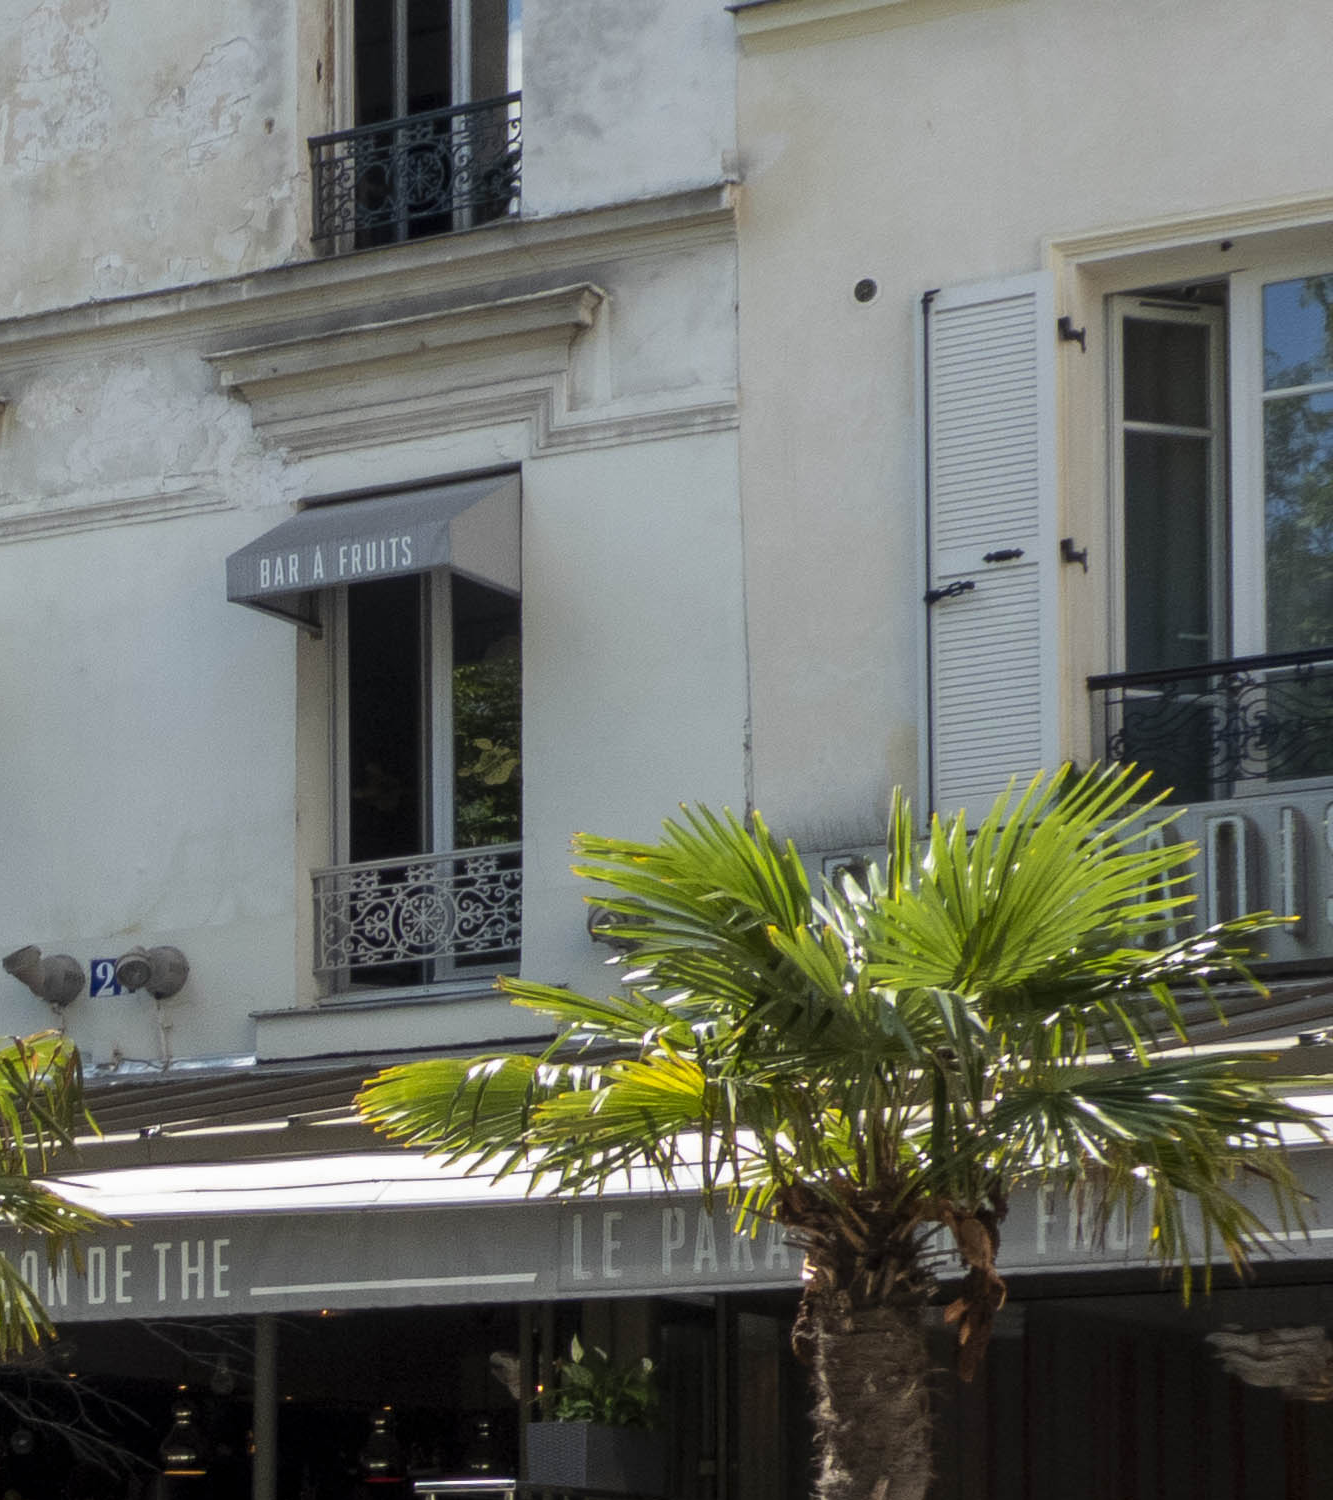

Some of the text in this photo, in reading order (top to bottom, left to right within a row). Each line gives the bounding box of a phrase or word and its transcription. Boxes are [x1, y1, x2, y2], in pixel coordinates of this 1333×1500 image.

[260, 553, 299, 588] BAR
[339, 535, 412, 576] FRUITS
[87, 1244, 133, 1305] DE
[153, 1238, 231, 1301] THE
[572, 1210, 623, 1281] LE
